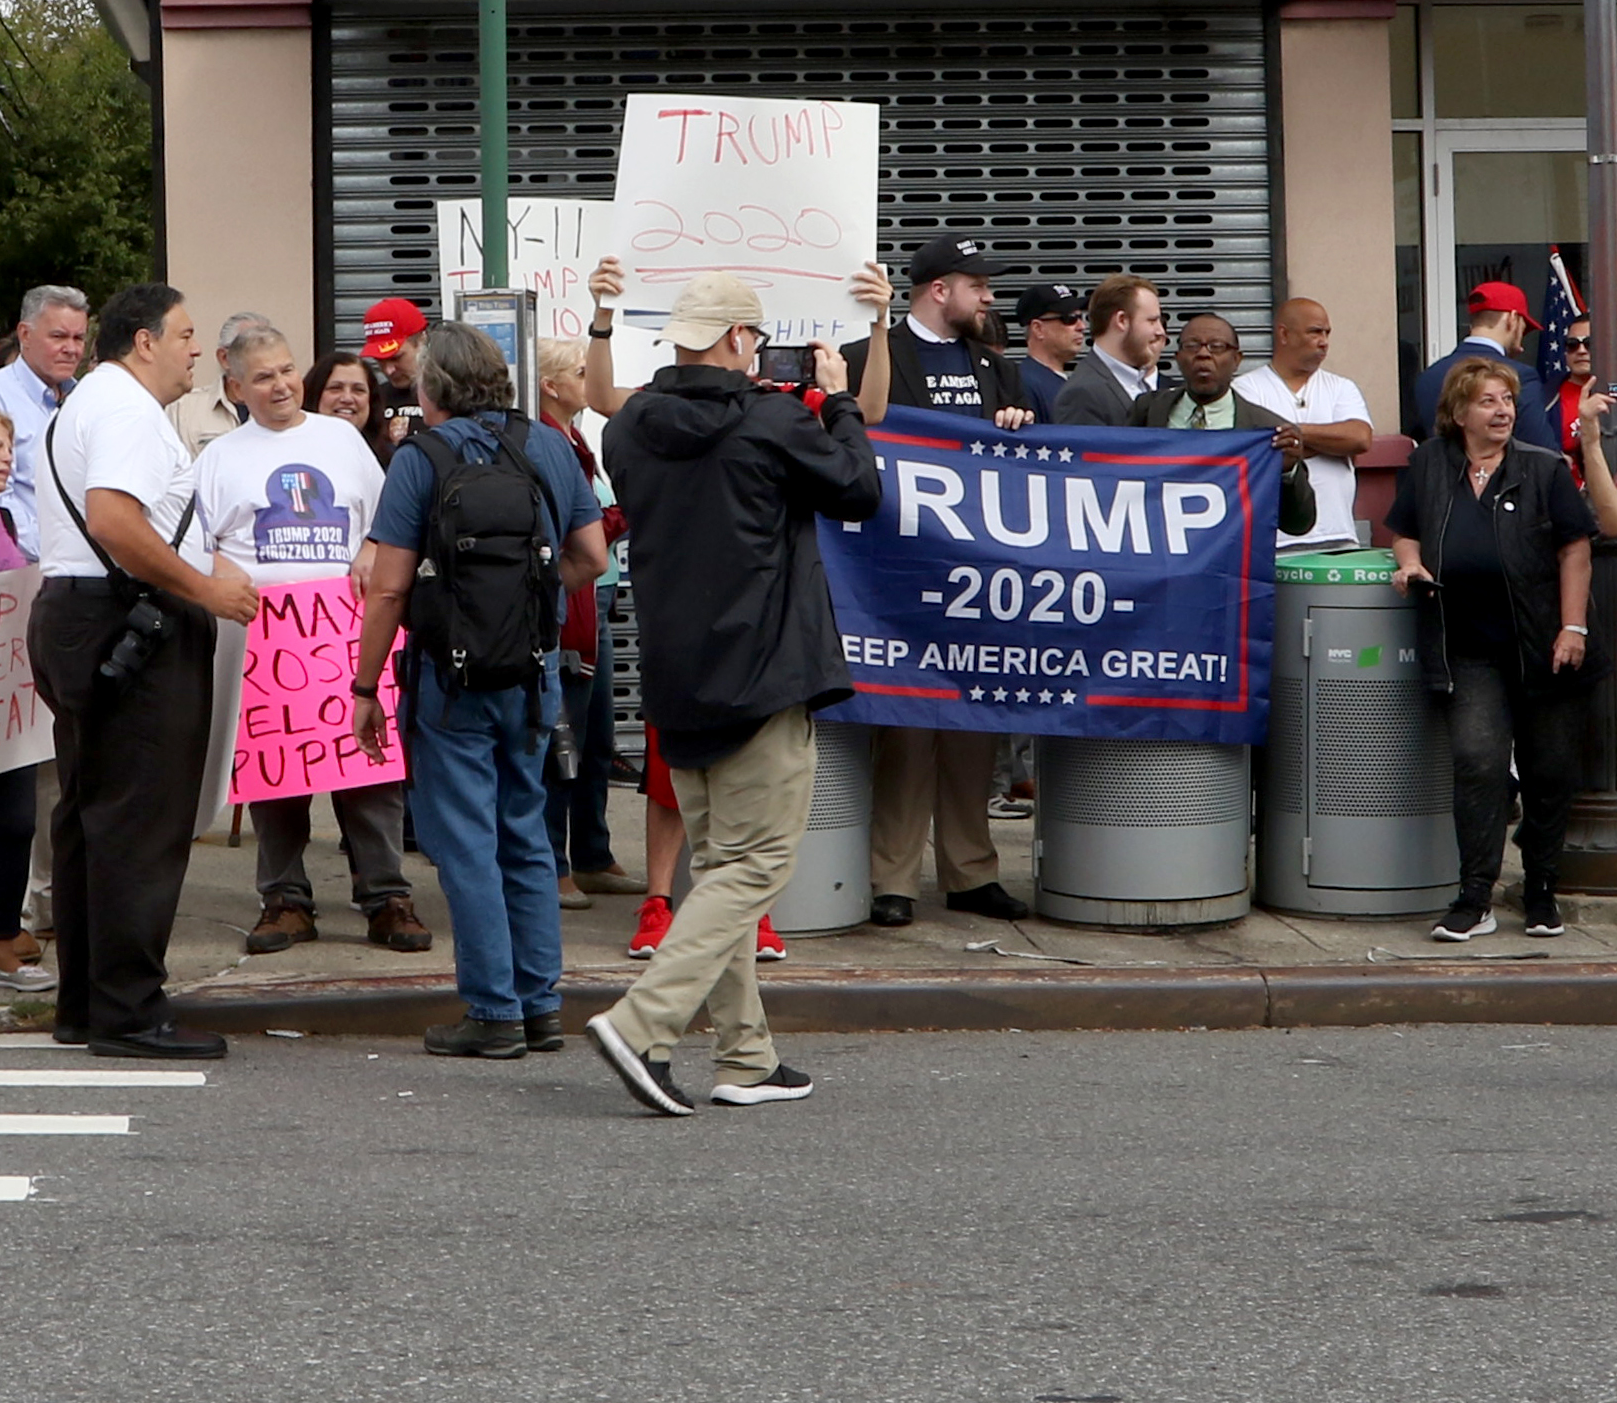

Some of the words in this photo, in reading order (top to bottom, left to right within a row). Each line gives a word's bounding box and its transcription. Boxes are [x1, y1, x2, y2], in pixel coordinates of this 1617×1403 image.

[658, 101, 843, 165] TRUMP
[631, 200, 842, 252] 2020
[939, 374, 979, 390] AMER
[955, 392, 982, 405] AGA
[842, 456, 1227, 555] RUMP
[267, 526, 310, 544] TRUMP
[313, 526, 342, 543] 2020
[1276, 568, 1314, 581] cycle
[262, 592, 364, 640] MAX
[841, 633, 909, 668] EEP
[918, 642, 1090, 677] AMERICA
[1101, 649, 1228, 683] GREAT!
